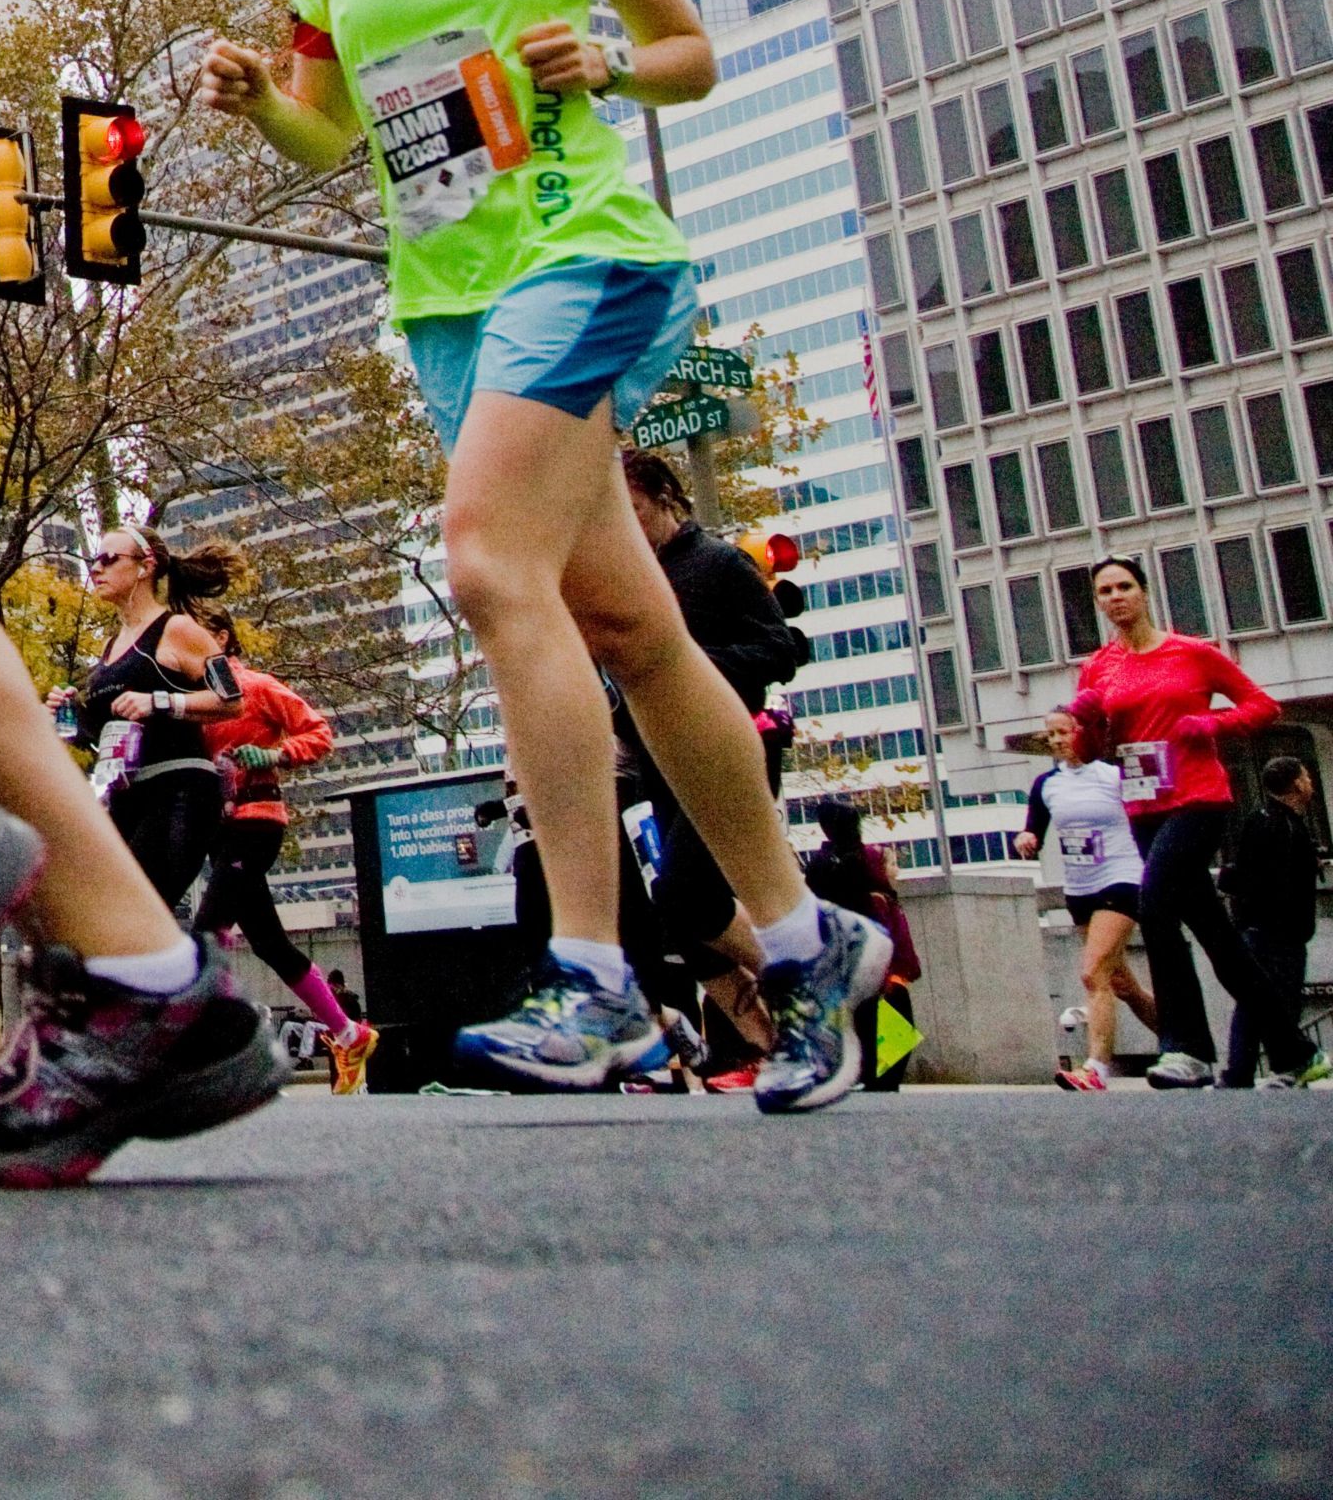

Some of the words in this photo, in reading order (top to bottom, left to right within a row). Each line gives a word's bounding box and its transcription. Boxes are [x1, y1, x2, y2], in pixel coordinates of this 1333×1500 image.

[376, 87, 412, 115] 2013
[388, 134, 450, 176] 12030
[665, 359, 726, 383] ARCH
[731, 370, 747, 385] ST
[637, 412, 702, 448] BROAD
[707, 410, 722, 428] ST
[98, 683, 125, 695] mother
[387, 813, 410, 826] Turn
[411, 813, 419, 825] a
[420, 808, 445, 823] class
[447, 803, 475, 822] proje
[390, 828, 411, 842] into
[412, 822, 477, 840] vaccinations
[390, 844, 418, 859] 1,000
[419, 840, 456, 855] babies.
